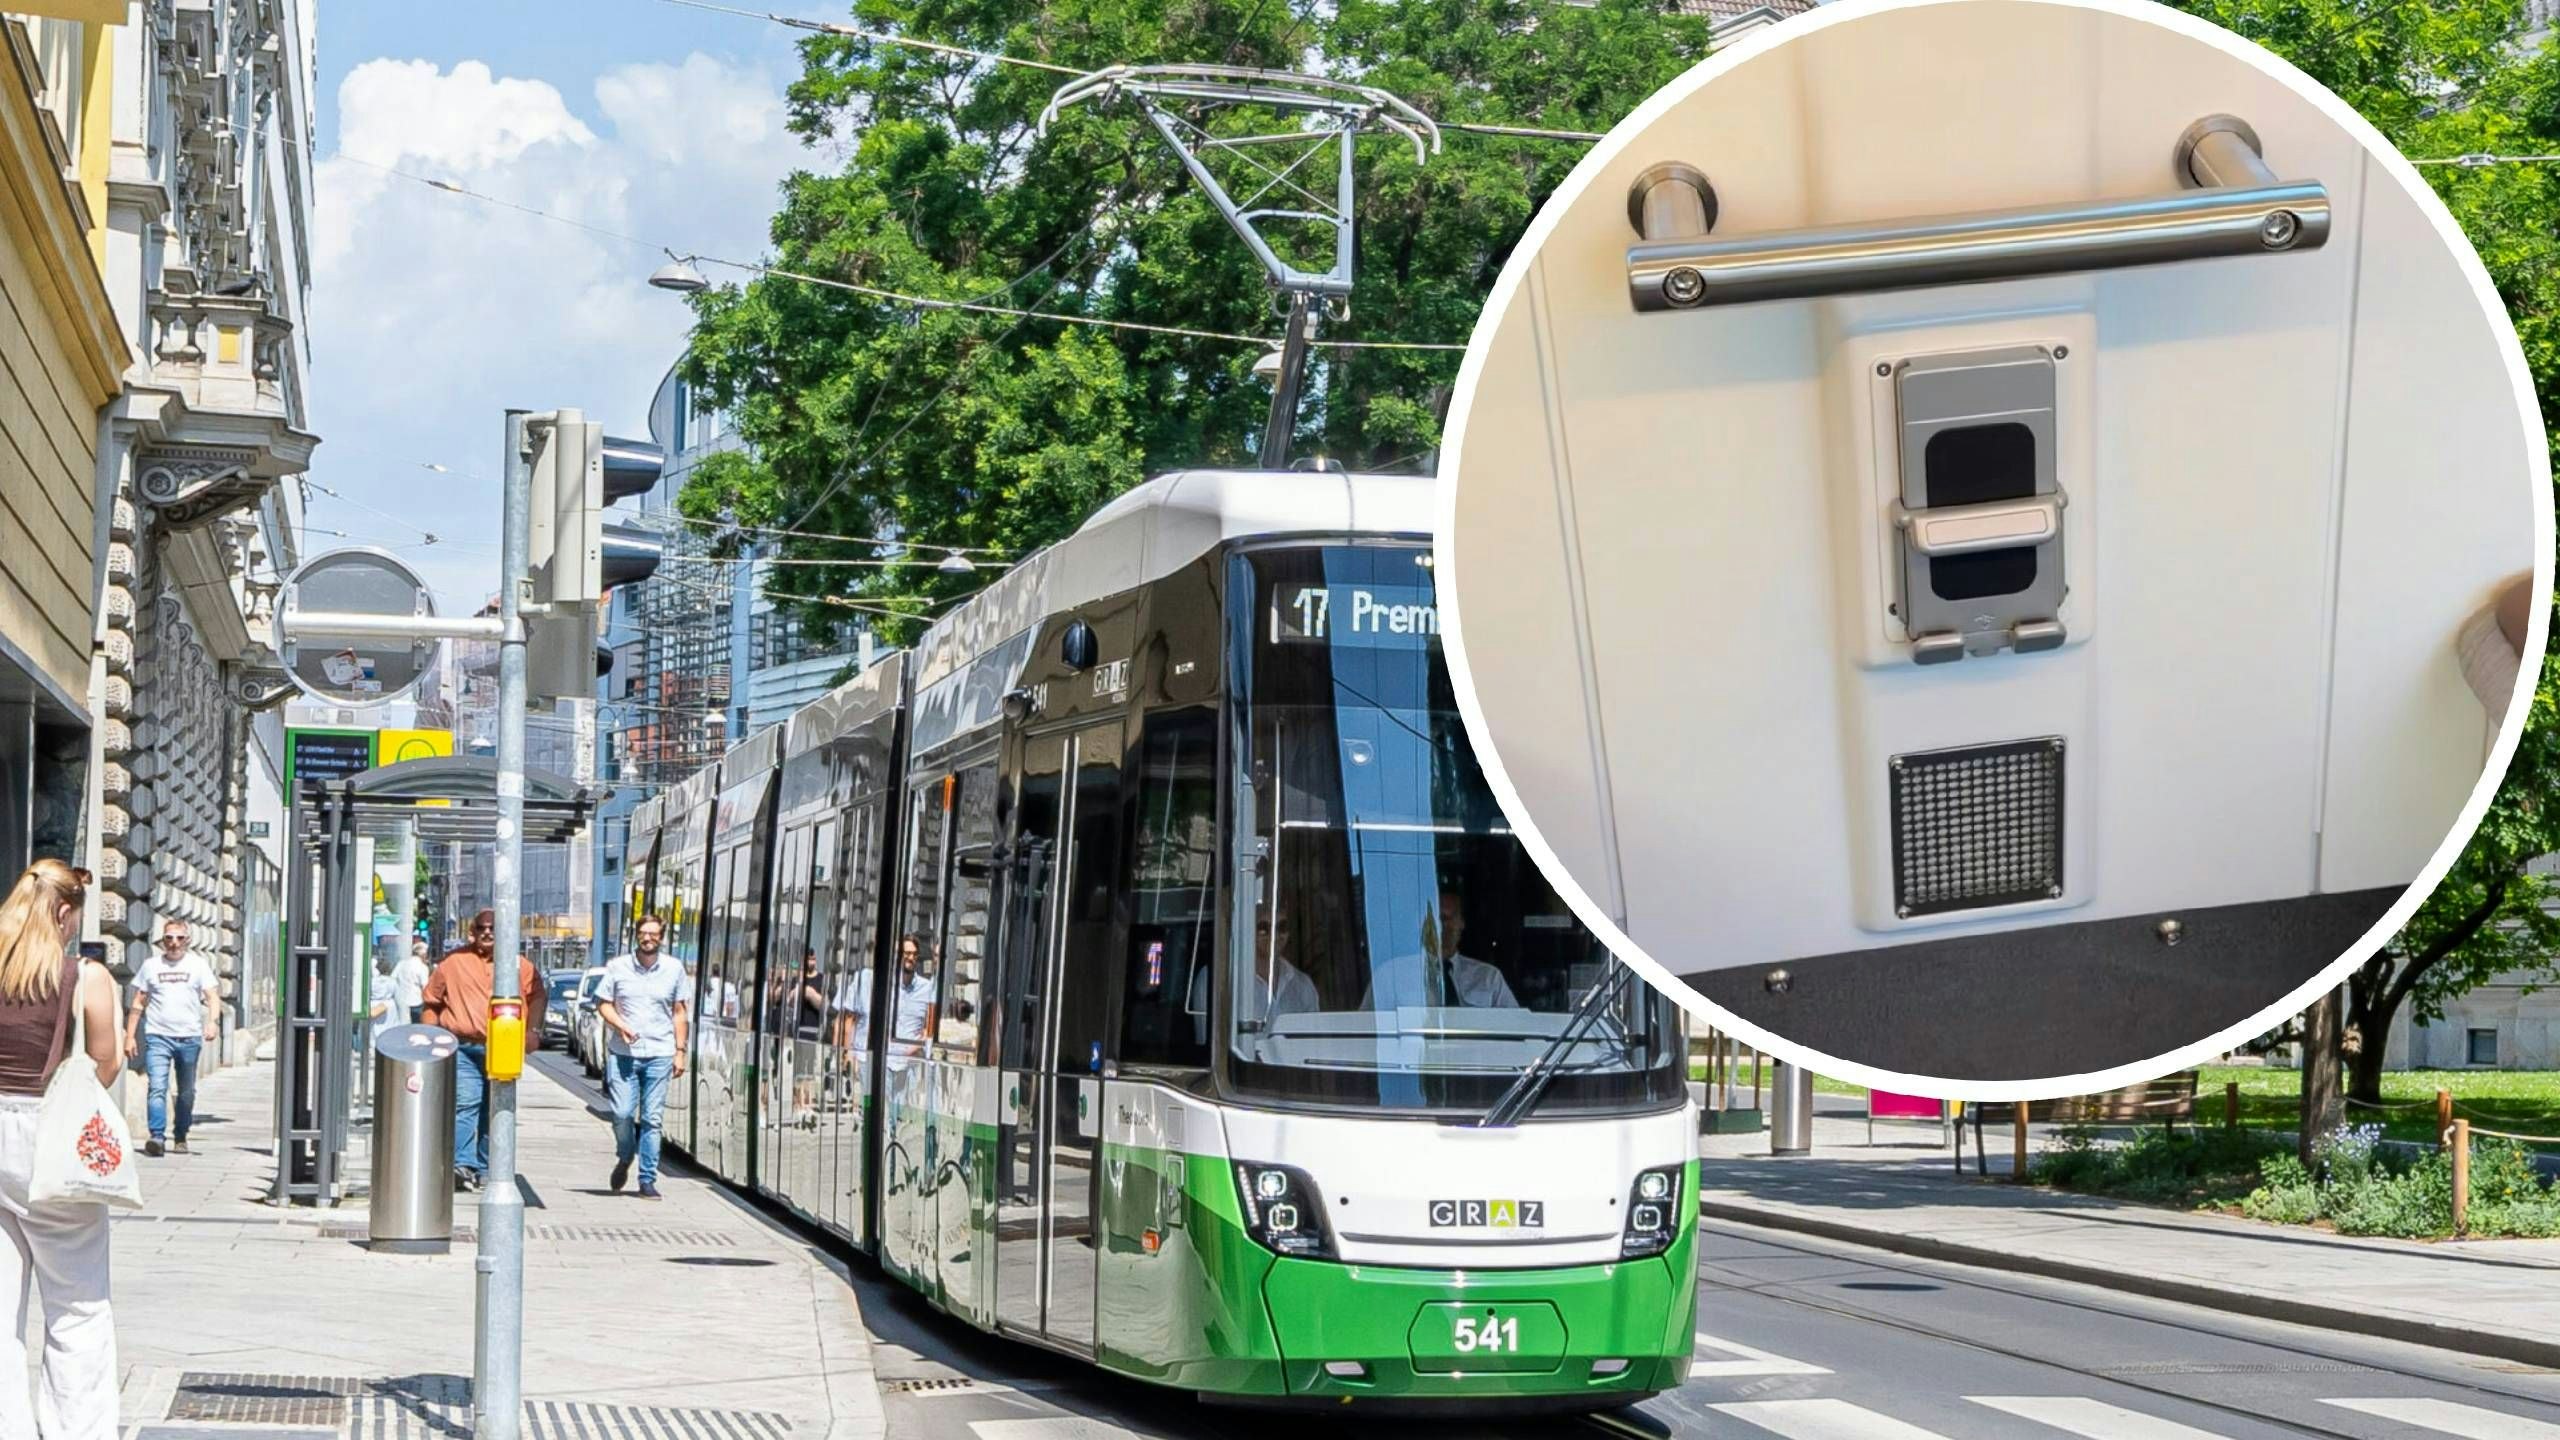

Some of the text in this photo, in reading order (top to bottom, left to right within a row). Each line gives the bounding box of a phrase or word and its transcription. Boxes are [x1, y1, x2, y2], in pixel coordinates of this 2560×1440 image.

[1293, 588, 1329, 637] 17
[1093, 661, 1129, 694] GRAZ
[1430, 1200, 1543, 1227] GRAZ
[1454, 1316, 1518, 1352] 541
